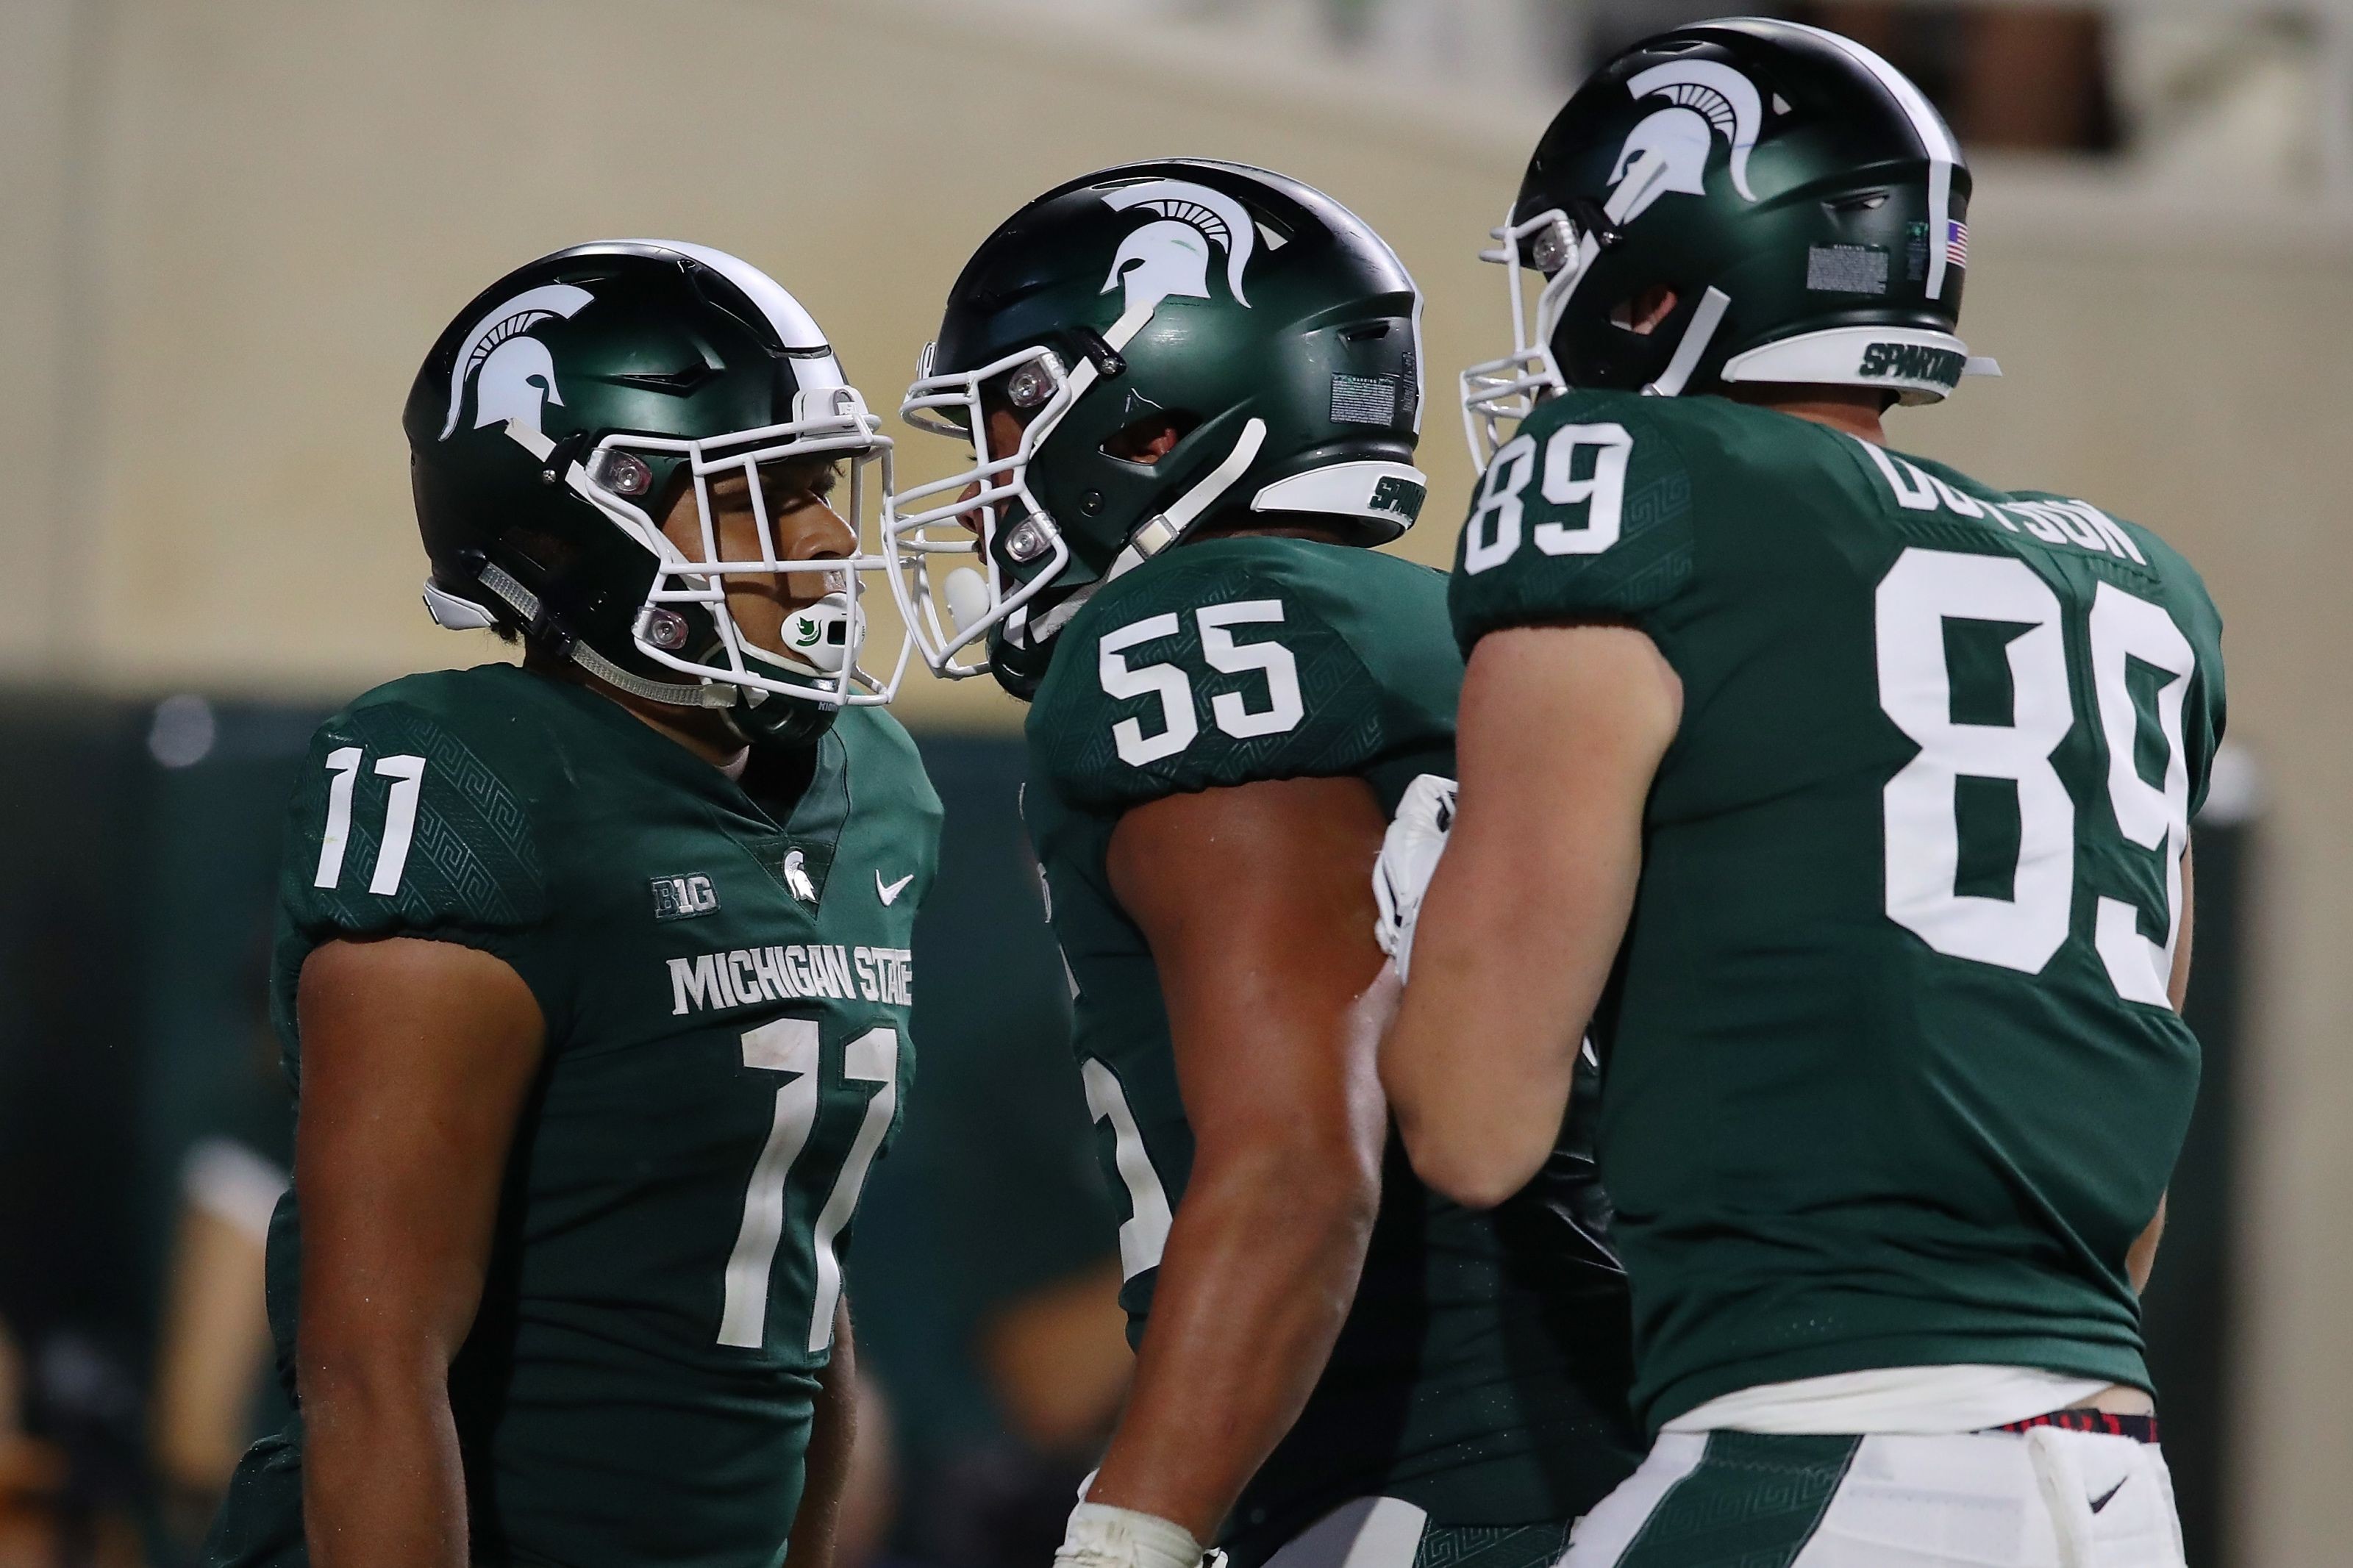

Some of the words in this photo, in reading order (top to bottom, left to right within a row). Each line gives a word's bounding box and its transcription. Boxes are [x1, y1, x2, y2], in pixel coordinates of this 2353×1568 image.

[1464, 422, 1634, 576] 89
[1099, 599, 1304, 767] 55
[314, 746, 426, 896] 11
[1875, 546, 2195, 1012] 89
[665, 945, 856, 1015] MICHIGAN
[854, 946, 912, 1006] STATE
[716, 1017, 897, 1352] 11
